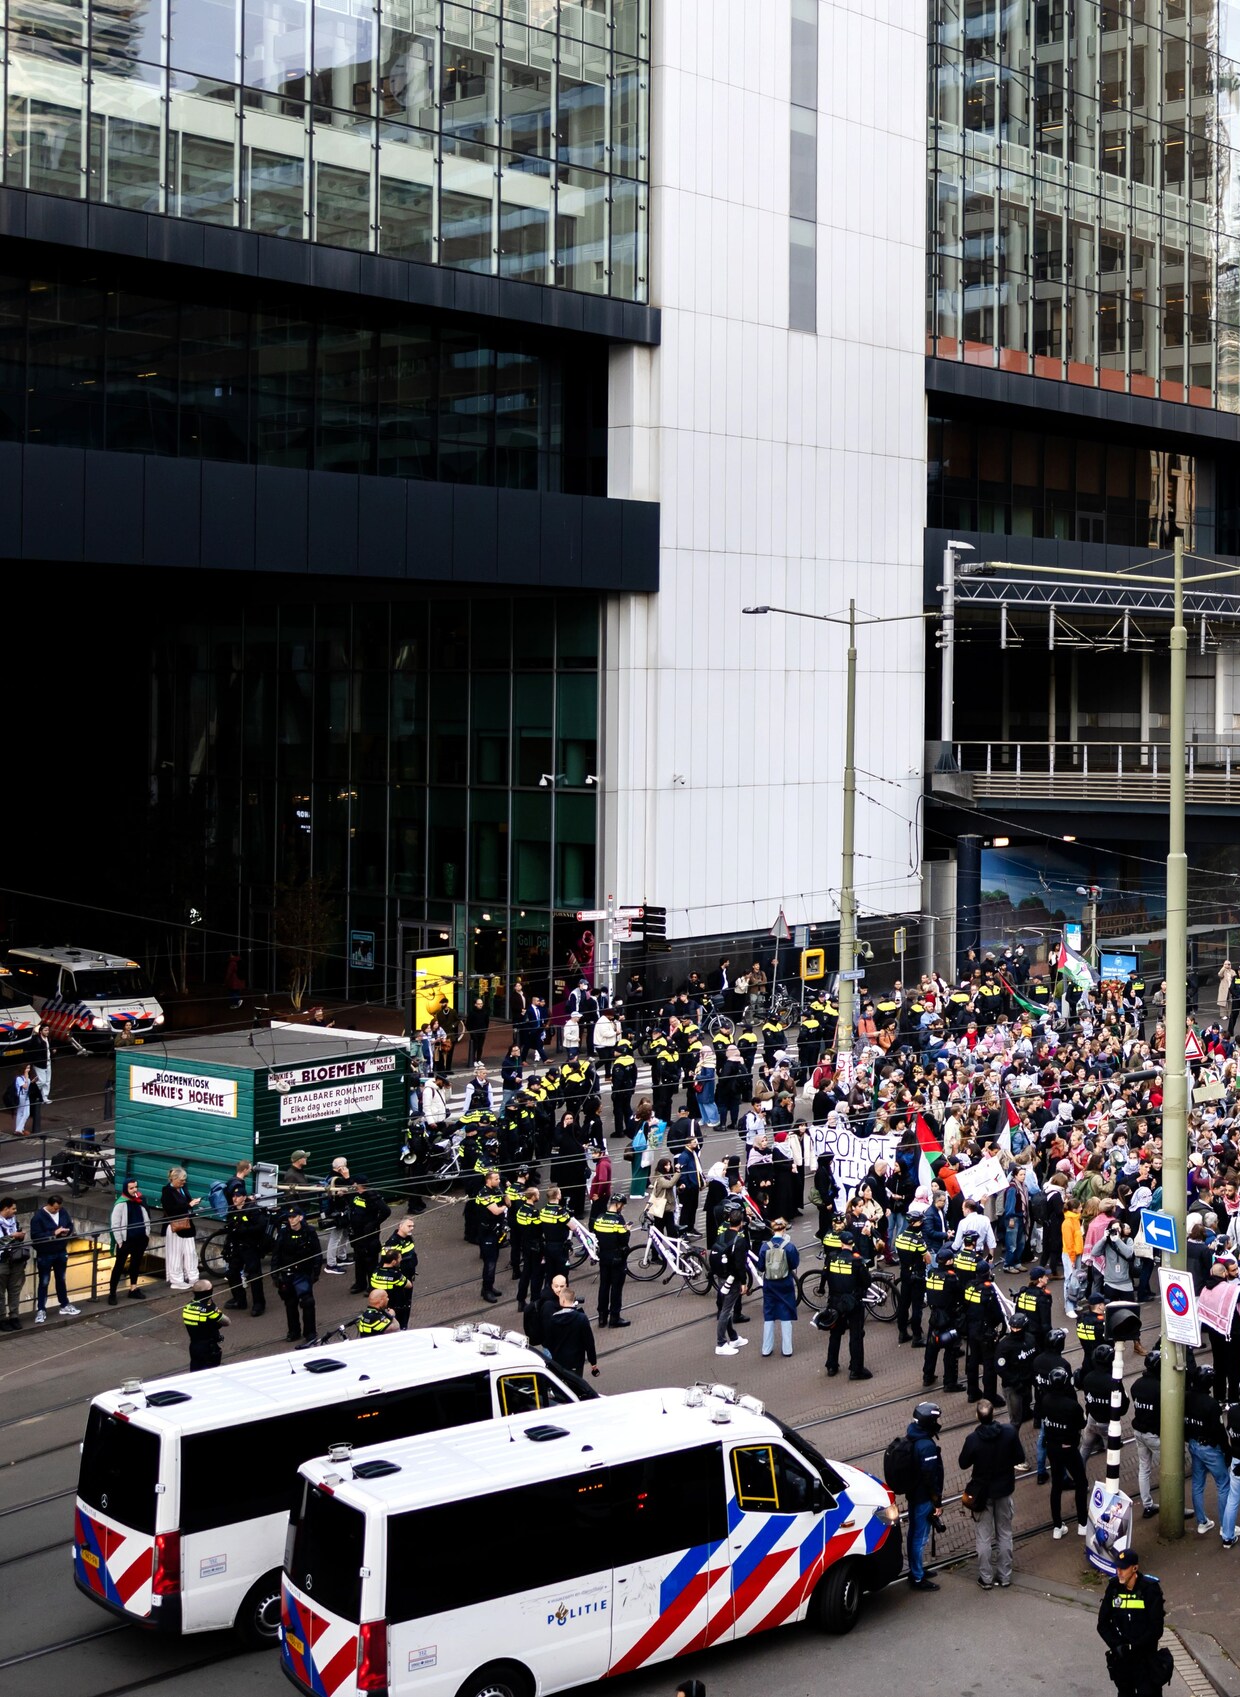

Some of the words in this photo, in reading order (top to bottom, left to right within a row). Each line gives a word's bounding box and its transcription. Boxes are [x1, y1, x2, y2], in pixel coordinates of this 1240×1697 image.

[156, 1073, 210, 1090] BLOEMENKIOSK
[301, 1061, 366, 1083] BLOEMEN
[142, 1082, 184, 1101] HENKIE'S
[188, 1089, 224, 1107] HOEKIE
[283, 1090, 334, 1106] BETAALBARE
[335, 1082, 381, 1097] ROMANTIEK
[290, 1105, 306, 1114] Elke
[307, 1102, 321, 1112] dag
[322, 1098, 343, 1108] verse
[343, 1094, 374, 1105] bloemen
[282, 1108, 341, 1123] www.henkieshoekie.nl
[815, 1129, 890, 1163] PROTECT
[547, 1599, 607, 1626] POLITIE
